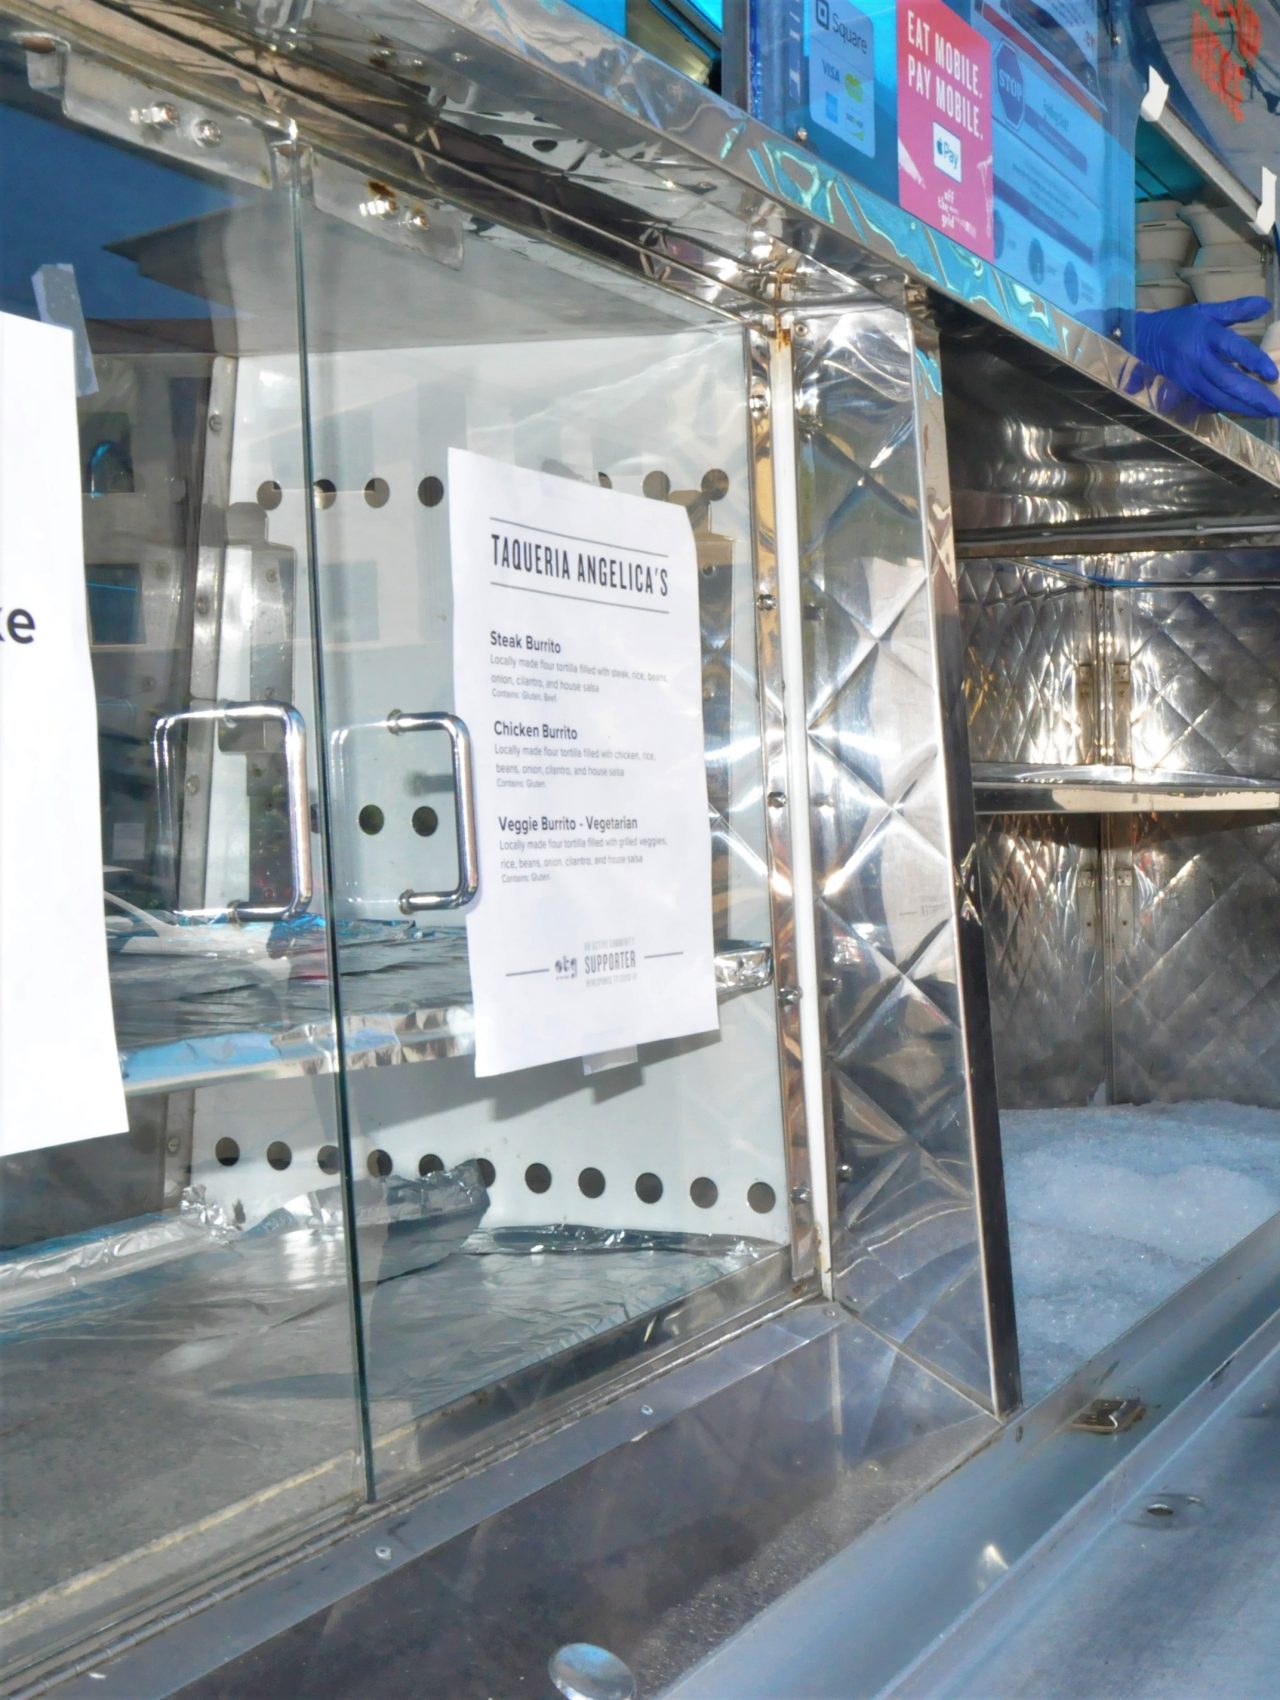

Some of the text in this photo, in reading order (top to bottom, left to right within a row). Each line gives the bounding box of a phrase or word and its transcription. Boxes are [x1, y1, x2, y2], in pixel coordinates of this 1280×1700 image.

[832, 13, 868, 54] Square
[908, 9, 982, 99] EAT MOBILE.
[821, 59, 840, 84] VISA
[908, 54, 931, 100] PAY
[936, 76, 983, 140] MOBILE.
[1000, 69, 1022, 102] STOP
[944, 142, 959, 170] Pay
[491, 534, 669, 597] TAQUERIA ANGELICA'S
[490, 630, 561, 654] Steak Burrito
[490, 653, 517, 668] Locally
[518, 658, 538, 669] made
[556, 661, 578, 673] tortilla
[579, 664, 596, 676] filled
[597, 667, 610, 677] with
[491, 673, 515, 685] onion,
[546, 679, 558, 690] and
[560, 680, 581, 691] house
[493, 720, 578, 740] Chicken Burrito
[494, 743, 521, 757] Locally
[522, 746, 542, 757] made
[560, 746, 582, 758] tortilla
[583, 747, 599, 758] filled
[601, 748, 613, 759] with
[574, 765, 586, 776] and
[588, 766, 607, 777] house
[498, 816, 538, 835] Veggie
[541, 816, 576, 831] Burrito
[585, 815, 638, 833] Vegetarian
[500, 839, 526, 852] Locally
[527, 839, 546, 850] made
[564, 838, 586, 849] tortilla
[587, 837, 604, 848] filled
[605, 837, 618, 847] with
[501, 858, 518, 870] rice,
[594, 855, 606, 865] and
[584, 950, 636, 975] SUPPORTER
